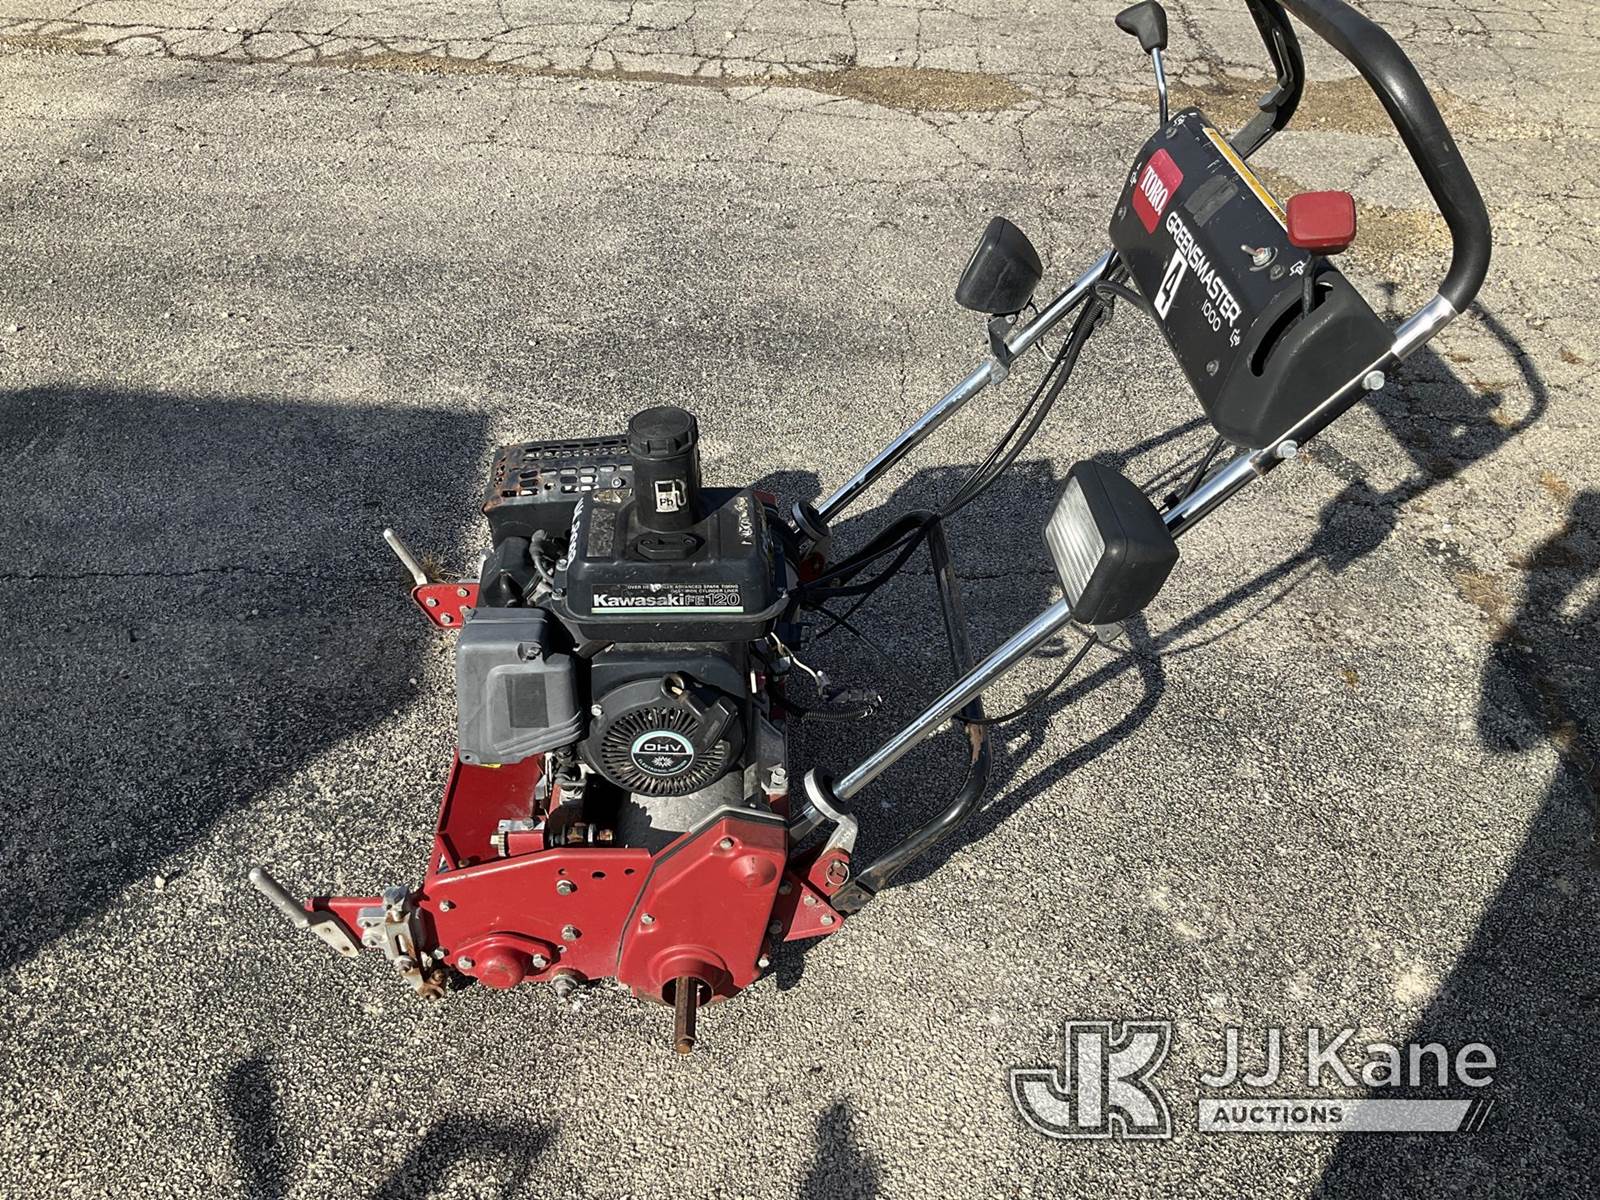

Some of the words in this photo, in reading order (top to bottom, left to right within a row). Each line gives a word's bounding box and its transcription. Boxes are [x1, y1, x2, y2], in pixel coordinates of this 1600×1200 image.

[1140, 165, 1168, 213] TORO
[1166, 211, 1241, 327] GREENSMASTER
[1201, 299, 1221, 331] 1000
[594, 594, 684, 606] Kawasaki
[644, 743, 681, 751] OHV
